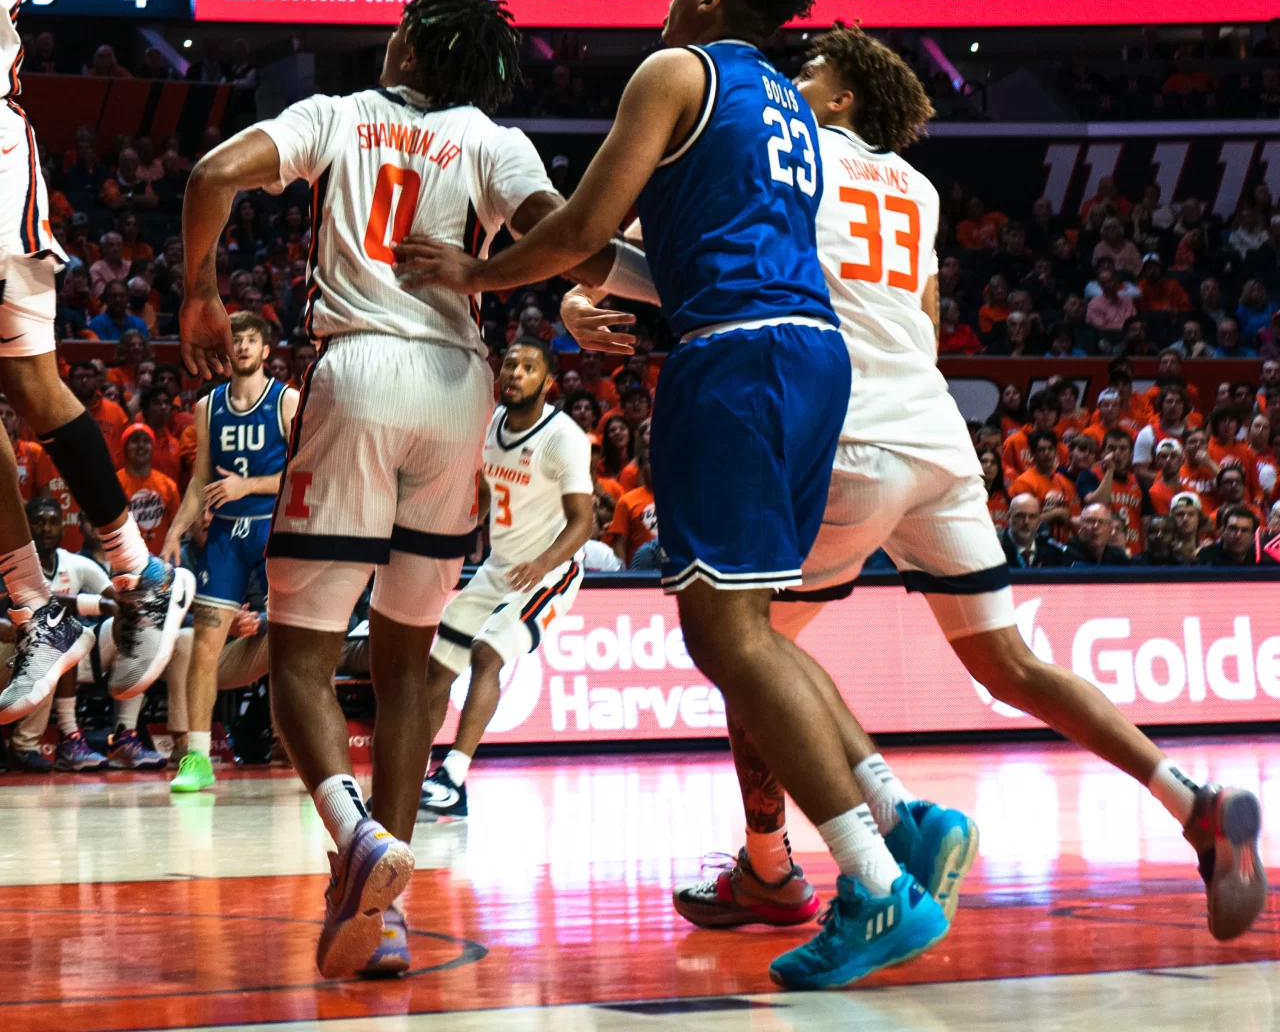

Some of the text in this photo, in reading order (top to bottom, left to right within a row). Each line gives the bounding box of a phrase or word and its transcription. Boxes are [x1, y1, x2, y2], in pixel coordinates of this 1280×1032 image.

[761, 75, 800, 113] BOLIS
[357, 122, 461, 170] SHANNON JR
[762, 106, 817, 197] 23
[840, 158, 909, 194] HAWKINS
[363, 162, 421, 266] 0
[838, 185, 921, 293] 33
[220, 424, 266, 452] EIU
[234, 456, 249, 479] 3
[494, 483, 512, 528] 3
[543, 614, 696, 670] Golde
[550, 674, 727, 731] Harves
